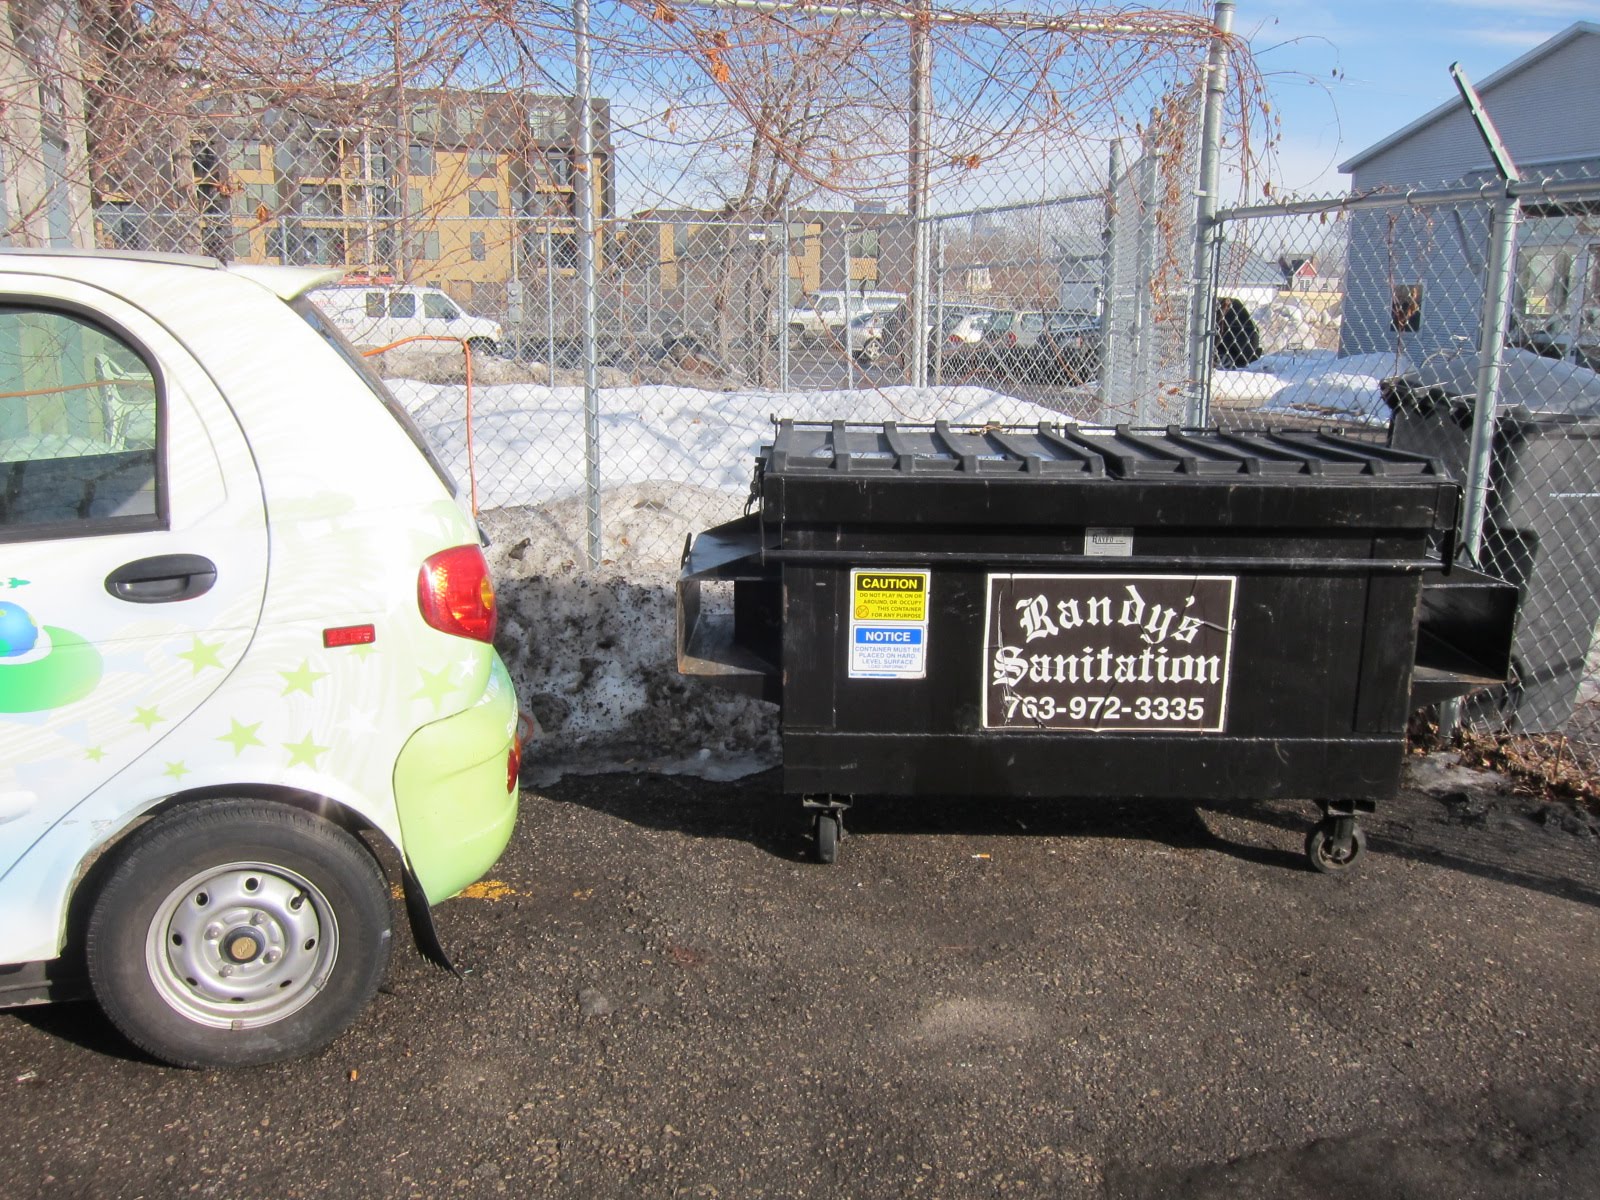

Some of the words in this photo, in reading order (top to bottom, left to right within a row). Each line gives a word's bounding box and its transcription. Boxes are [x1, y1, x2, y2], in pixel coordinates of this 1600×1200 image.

[862, 578, 918, 589] CAUTION
[1015, 584, 1205, 644] Randy's
[865, 631, 911, 642] NOTICE
[992, 645, 1221, 688] Sanitation
[1004, 696, 1205, 721] 763-972-3335
